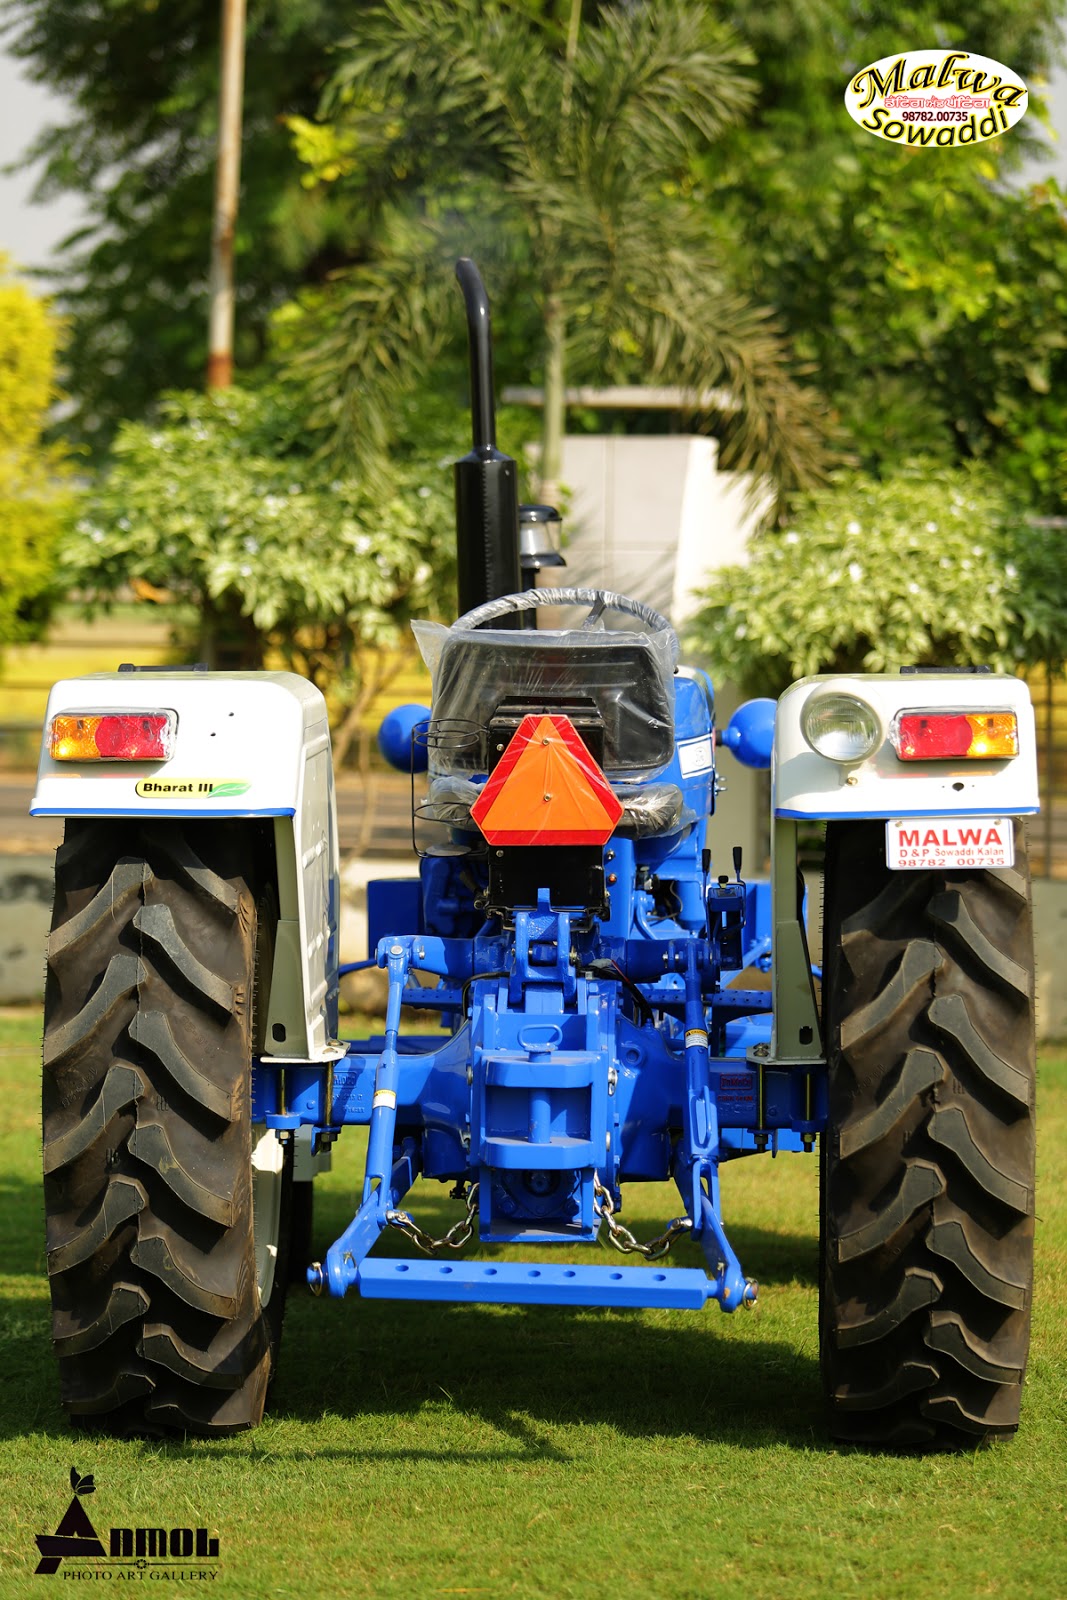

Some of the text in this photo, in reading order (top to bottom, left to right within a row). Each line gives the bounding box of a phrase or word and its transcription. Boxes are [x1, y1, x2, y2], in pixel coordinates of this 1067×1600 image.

[143, 783, 213, 792] Bharat III
[898, 828, 1003, 847] MALWA
[899, 847, 1004, 858] D & P Sowaddi Kalan
[898, 858, 1005, 867] 98782 00735
